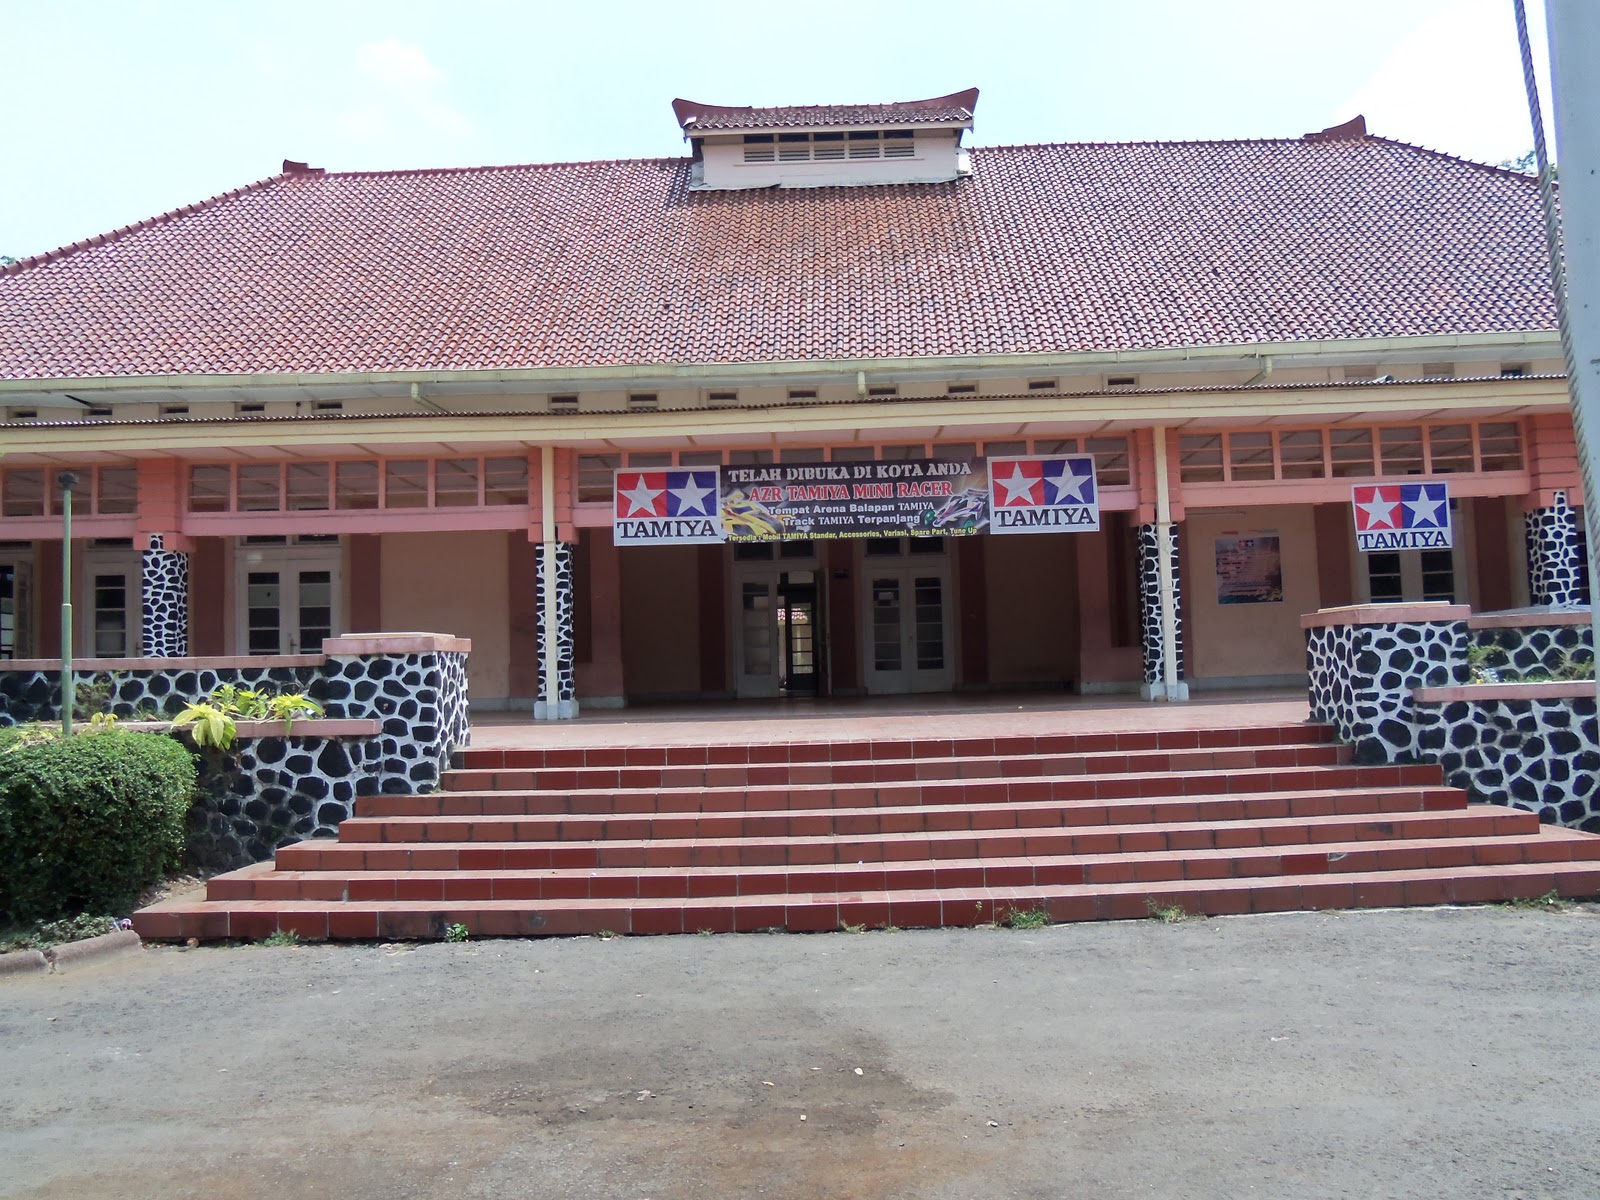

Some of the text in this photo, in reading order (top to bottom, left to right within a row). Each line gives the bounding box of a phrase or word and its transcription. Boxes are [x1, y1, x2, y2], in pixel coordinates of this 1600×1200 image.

[728, 462, 972, 482] TELAH DIBUKA DI KOTA ANDA
[749, 481, 954, 502] AZR TAMIYA MINI RACER
[768, 502, 934, 515] Tempat Arena Balapan TAMIYA
[994, 507, 1096, 527] TAMIYA
[617, 520, 718, 538] TAMIYA
[783, 514, 920, 526] Track TAMIYA Terpanjang
[1358, 531, 1450, 549] TAMIYA
